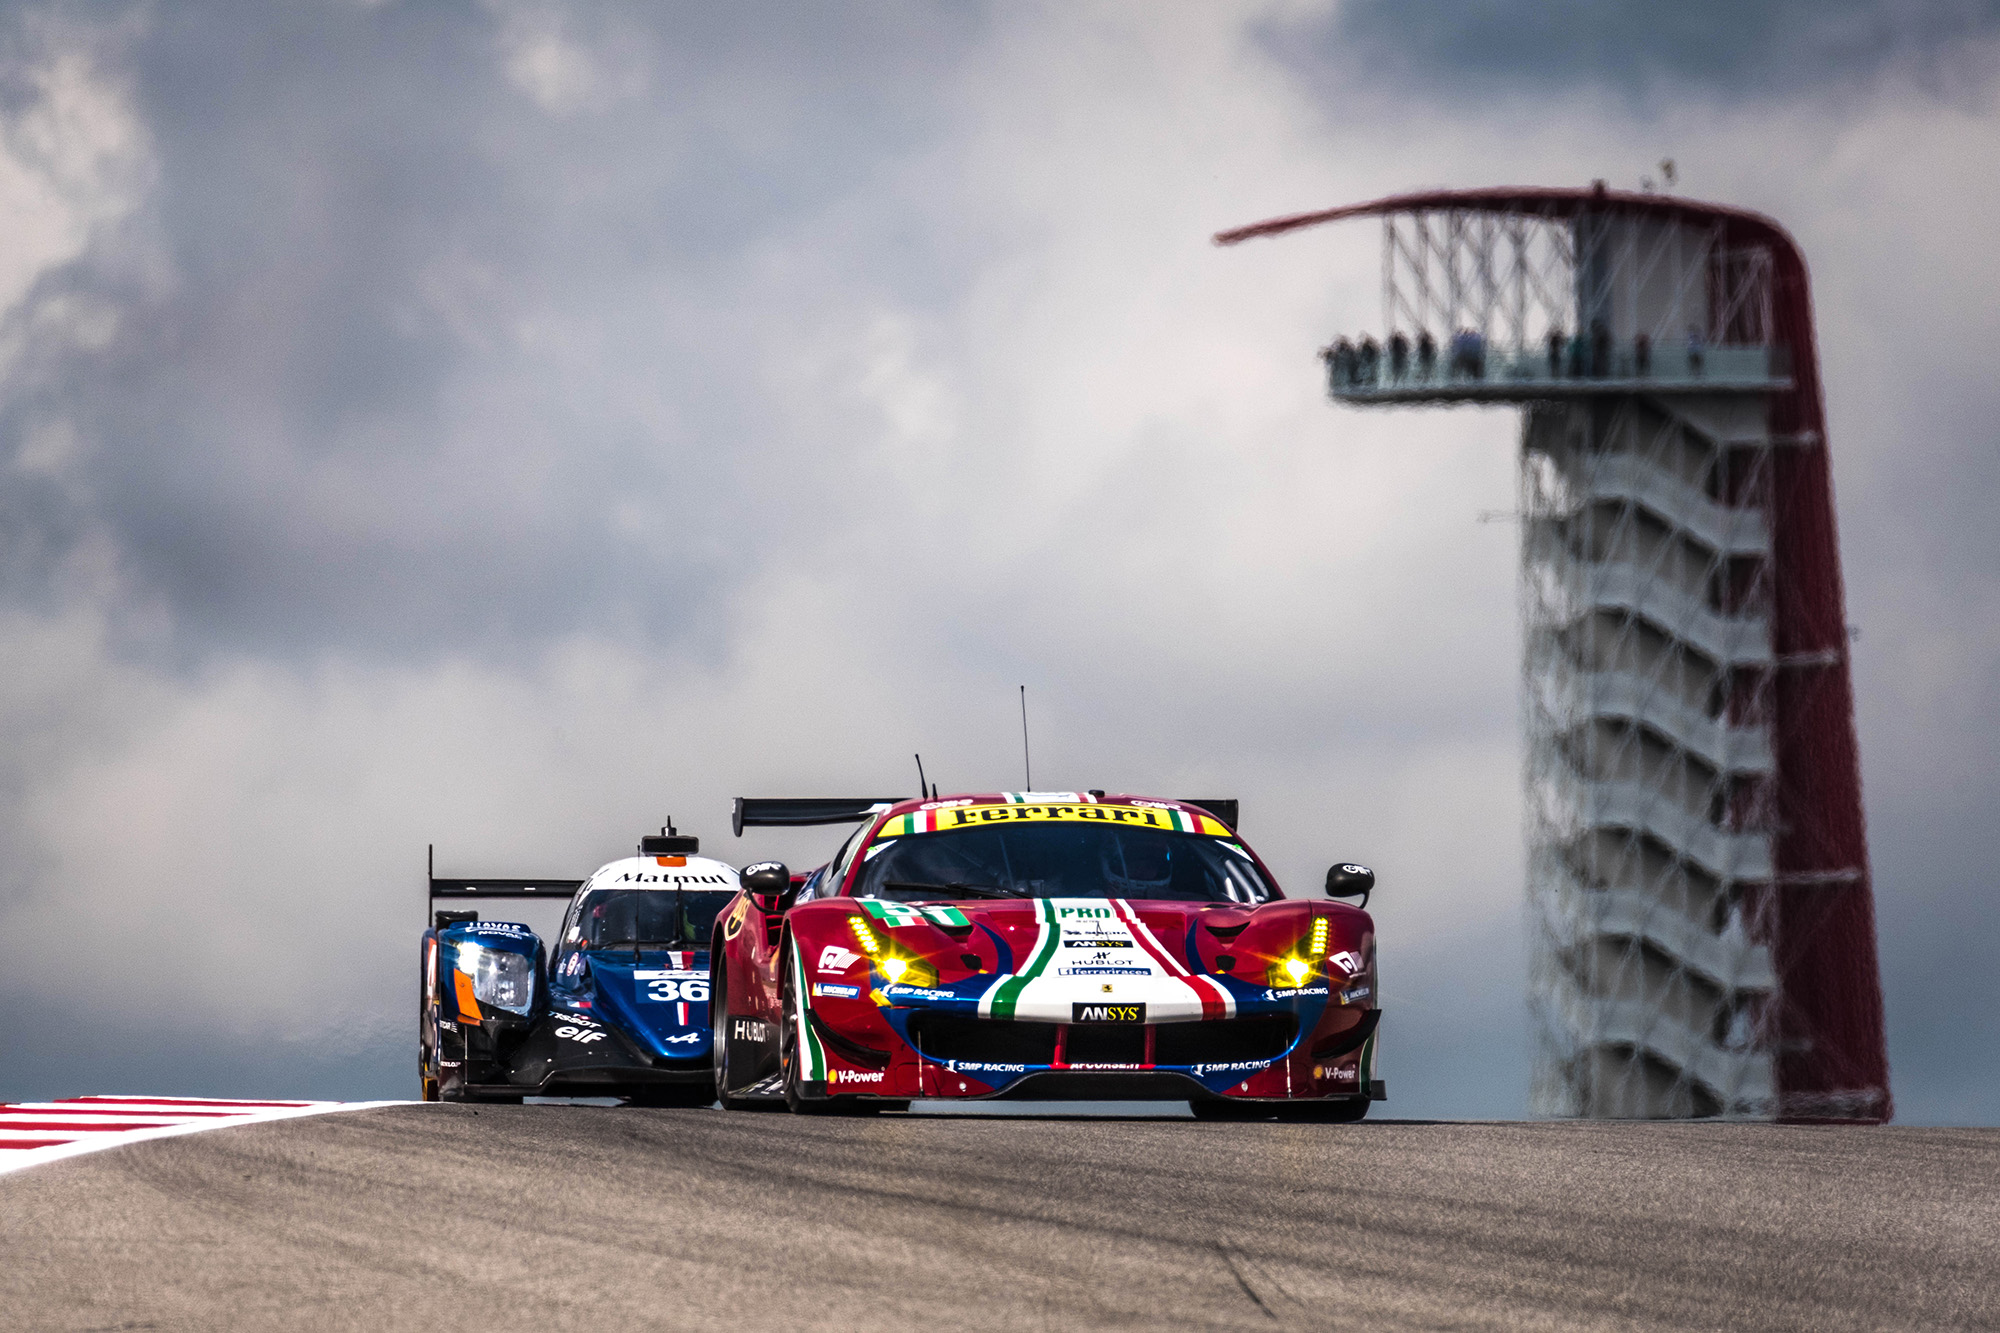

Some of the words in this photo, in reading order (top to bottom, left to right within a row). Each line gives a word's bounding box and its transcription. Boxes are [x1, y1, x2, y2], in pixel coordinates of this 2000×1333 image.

[950, 805, 1162, 827] Ferrari
[615, 872, 731, 886] Matmut
[1060, 907, 1111, 919] PRO
[1075, 967, 1149, 976] ferrariraces
[647, 979, 710, 1002] 36
[913, 988, 955, 999] RACING
[1275, 989, 1297, 999] SMP
[1298, 986, 1329, 996] RACING
[548, 1011, 602, 1028] TISSOT
[1081, 1005, 1140, 1021] ANSYS
[555, 1026, 607, 1044] elf
[957, 1061, 982, 1071] SMP
[983, 1062, 1024, 1073] RACING
[1205, 1062, 1229, 1073] SMP
[1230, 1059, 1271, 1071] RACING
[1324, 1066, 1356, 1079] V-Power
[838, 1069, 884, 1084] V-Power
